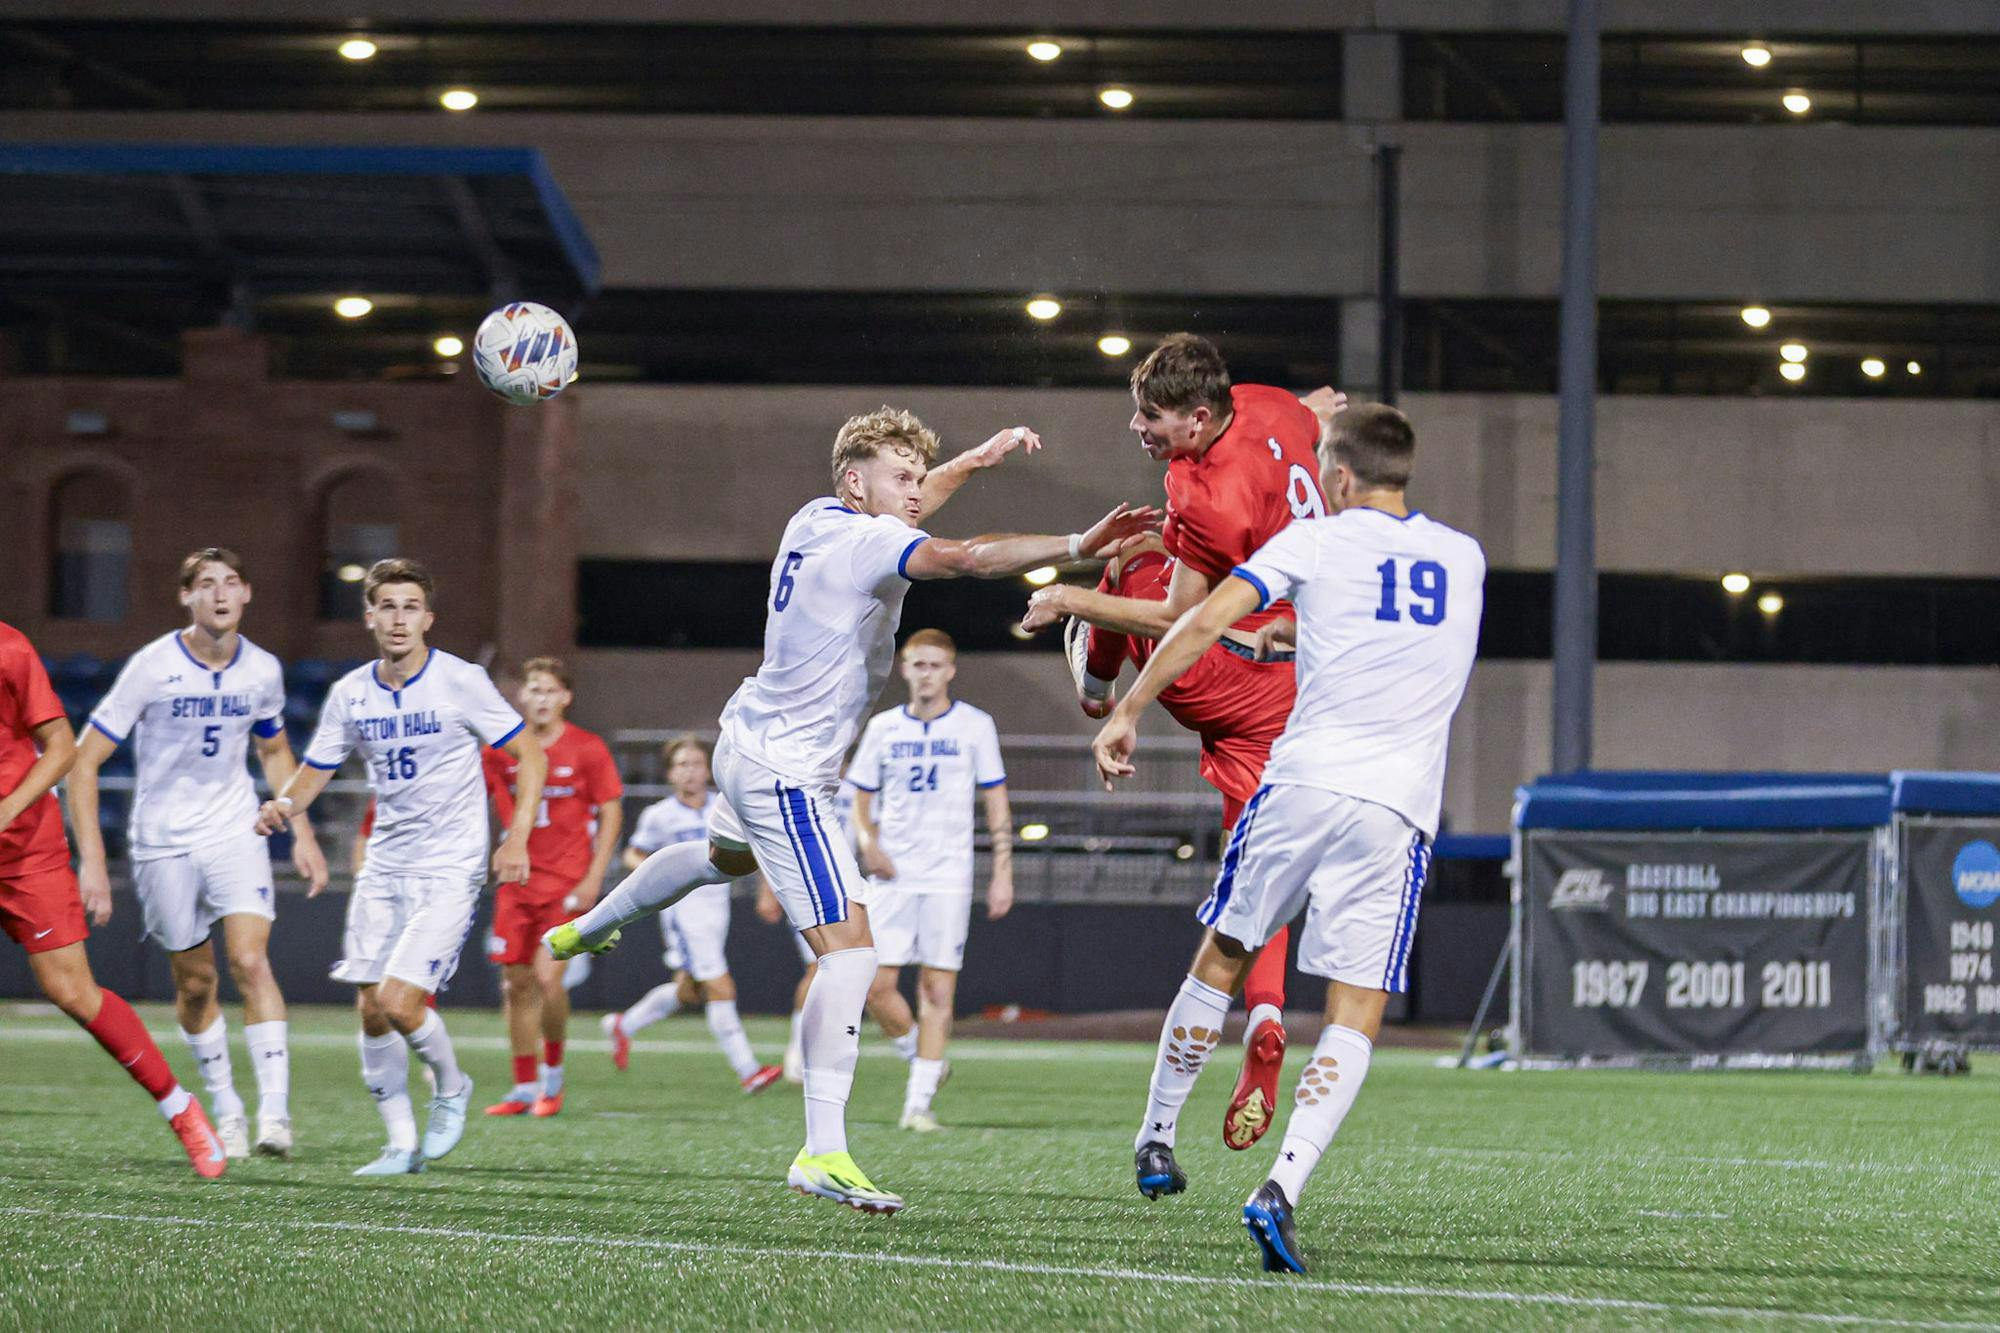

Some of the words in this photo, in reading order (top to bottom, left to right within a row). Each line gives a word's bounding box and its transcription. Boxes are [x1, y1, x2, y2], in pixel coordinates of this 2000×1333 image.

[1286, 463, 1326, 519] 9
[774, 551, 804, 613] 6
[1376, 558, 1447, 626] 19
[172, 696, 216, 717] SETON
[221, 695, 251, 716] HALL
[202, 725, 222, 757] 5
[355, 716, 399, 741] SETON
[403, 710, 442, 737] HALL
[386, 746, 418, 781] 16
[891, 741, 924, 759] SETON
[930, 739, 961, 756] HALL
[909, 764, 938, 792] 24
[1627, 864, 1721, 889] BASEBALL
[1627, 893, 1659, 918] BIG
[1663, 893, 1708, 918] EAST
[1711, 891, 1856, 918] CHAMPIONSHIPS
[1573, 960, 1649, 1008] 1987
[1666, 960, 1745, 1008] 2001
[1761, 960, 1832, 1008] 2011
